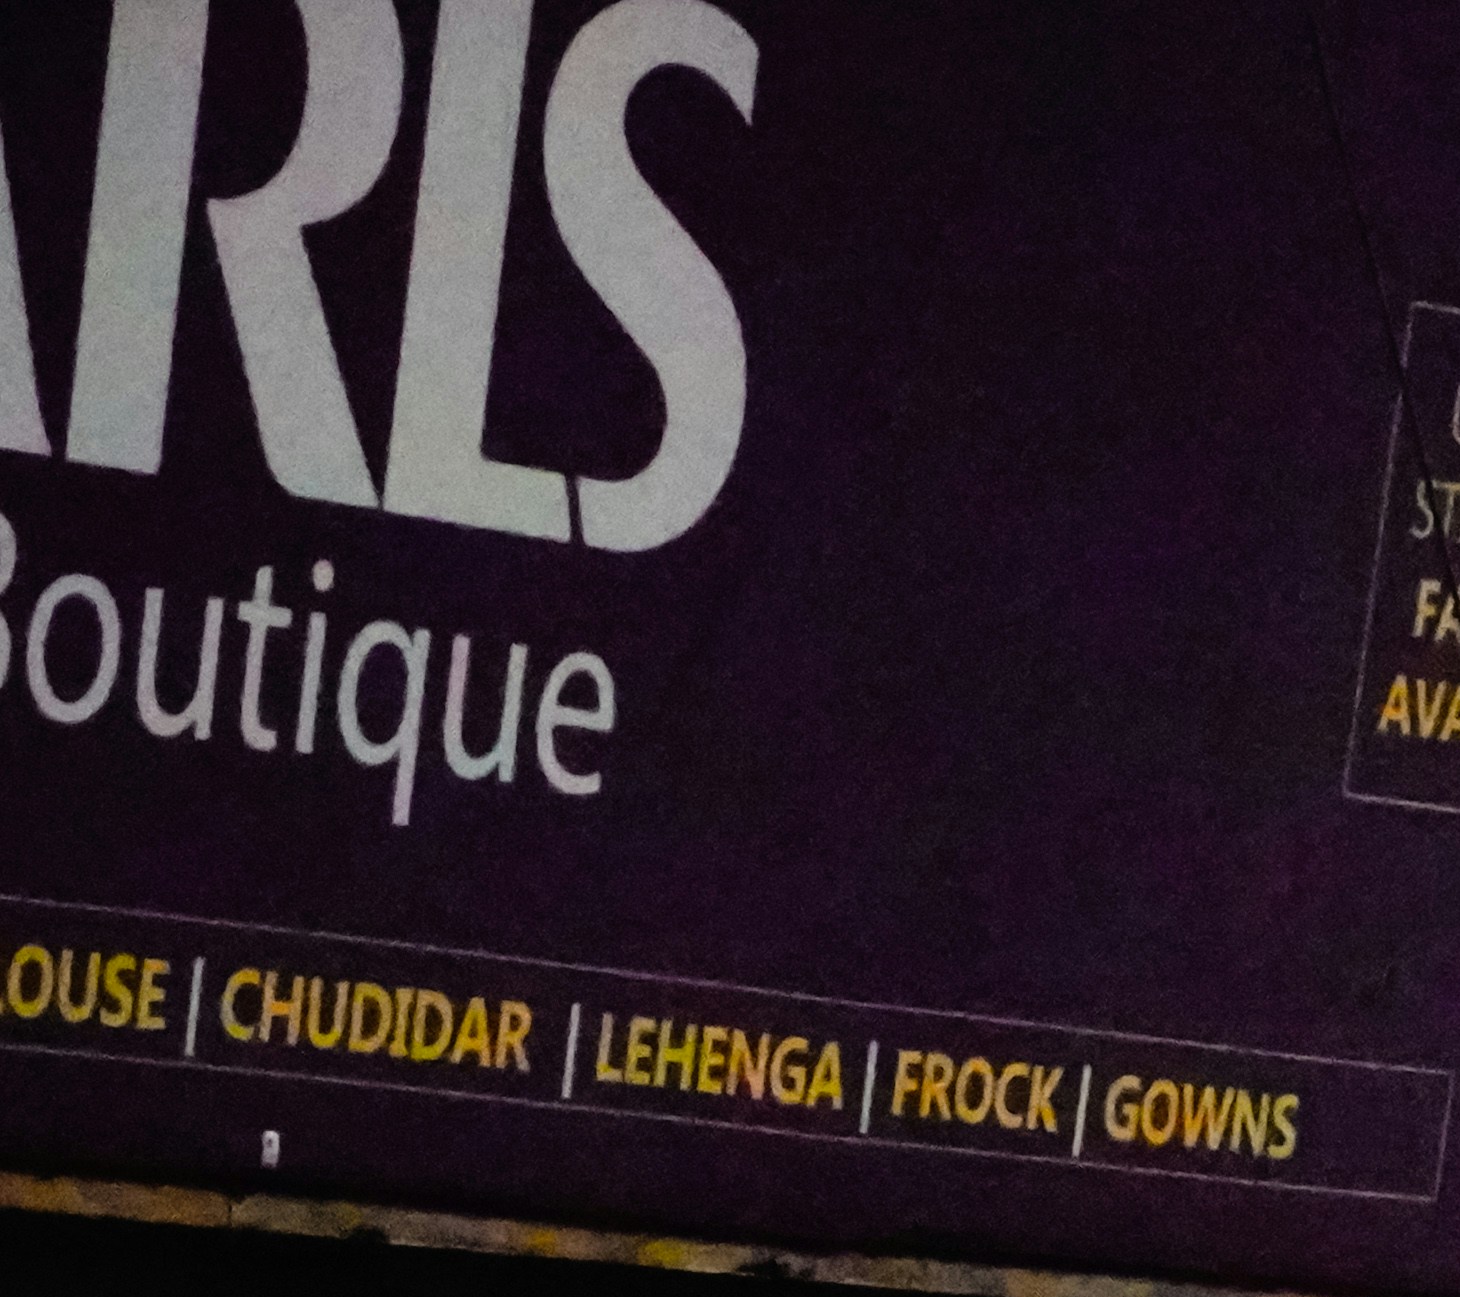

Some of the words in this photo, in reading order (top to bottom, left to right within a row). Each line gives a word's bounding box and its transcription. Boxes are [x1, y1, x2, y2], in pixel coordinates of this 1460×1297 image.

[0, 0, 760, 554] RLS
[0, 510, 617, 826] outique
[0, 943, 171, 1033] OUSE
[219, 967, 532, 1075] CHUDIDAR
[594, 1011, 845, 1111] LEHENGA
[891, 1048, 1066, 1135] FROCK
[1103, 1073, 1301, 1161] GOWNS
